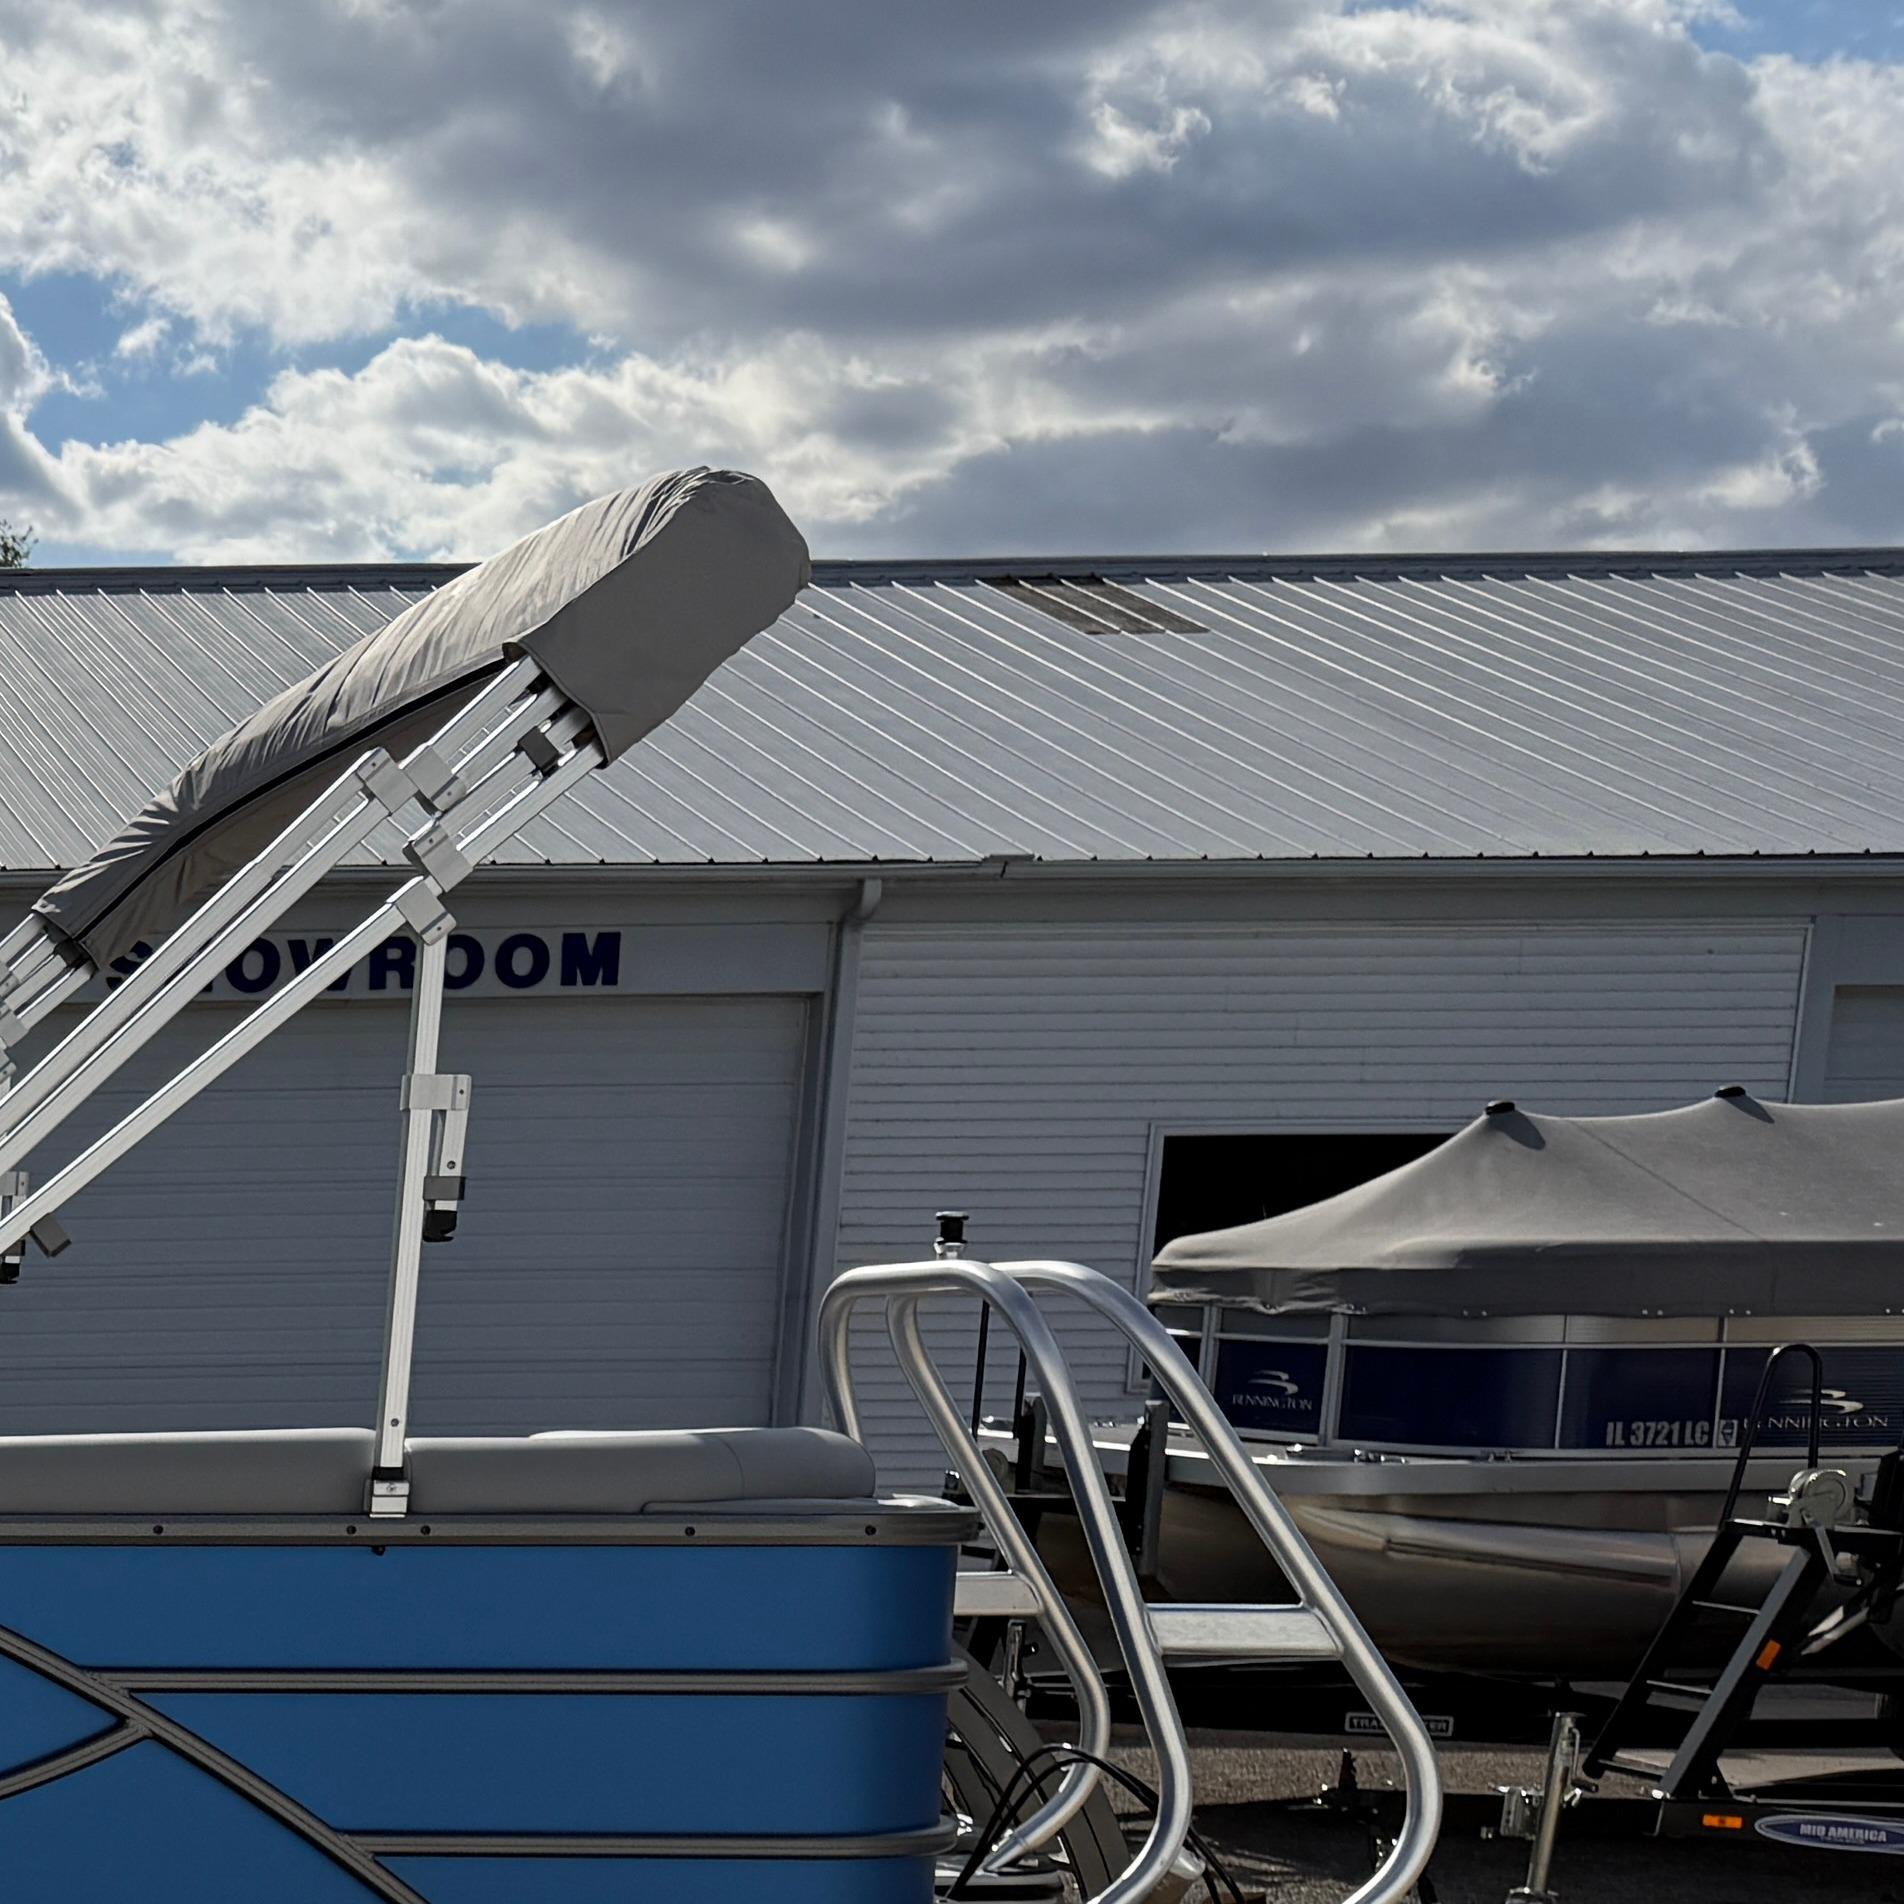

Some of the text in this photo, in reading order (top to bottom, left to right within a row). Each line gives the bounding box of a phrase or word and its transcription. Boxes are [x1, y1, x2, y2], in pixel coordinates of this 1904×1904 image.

[1605, 1419, 1709, 1446] IL 3721 LC
[1799, 1823, 1827, 1837] MID
[1827, 1826, 1888, 1842] AMERICA
